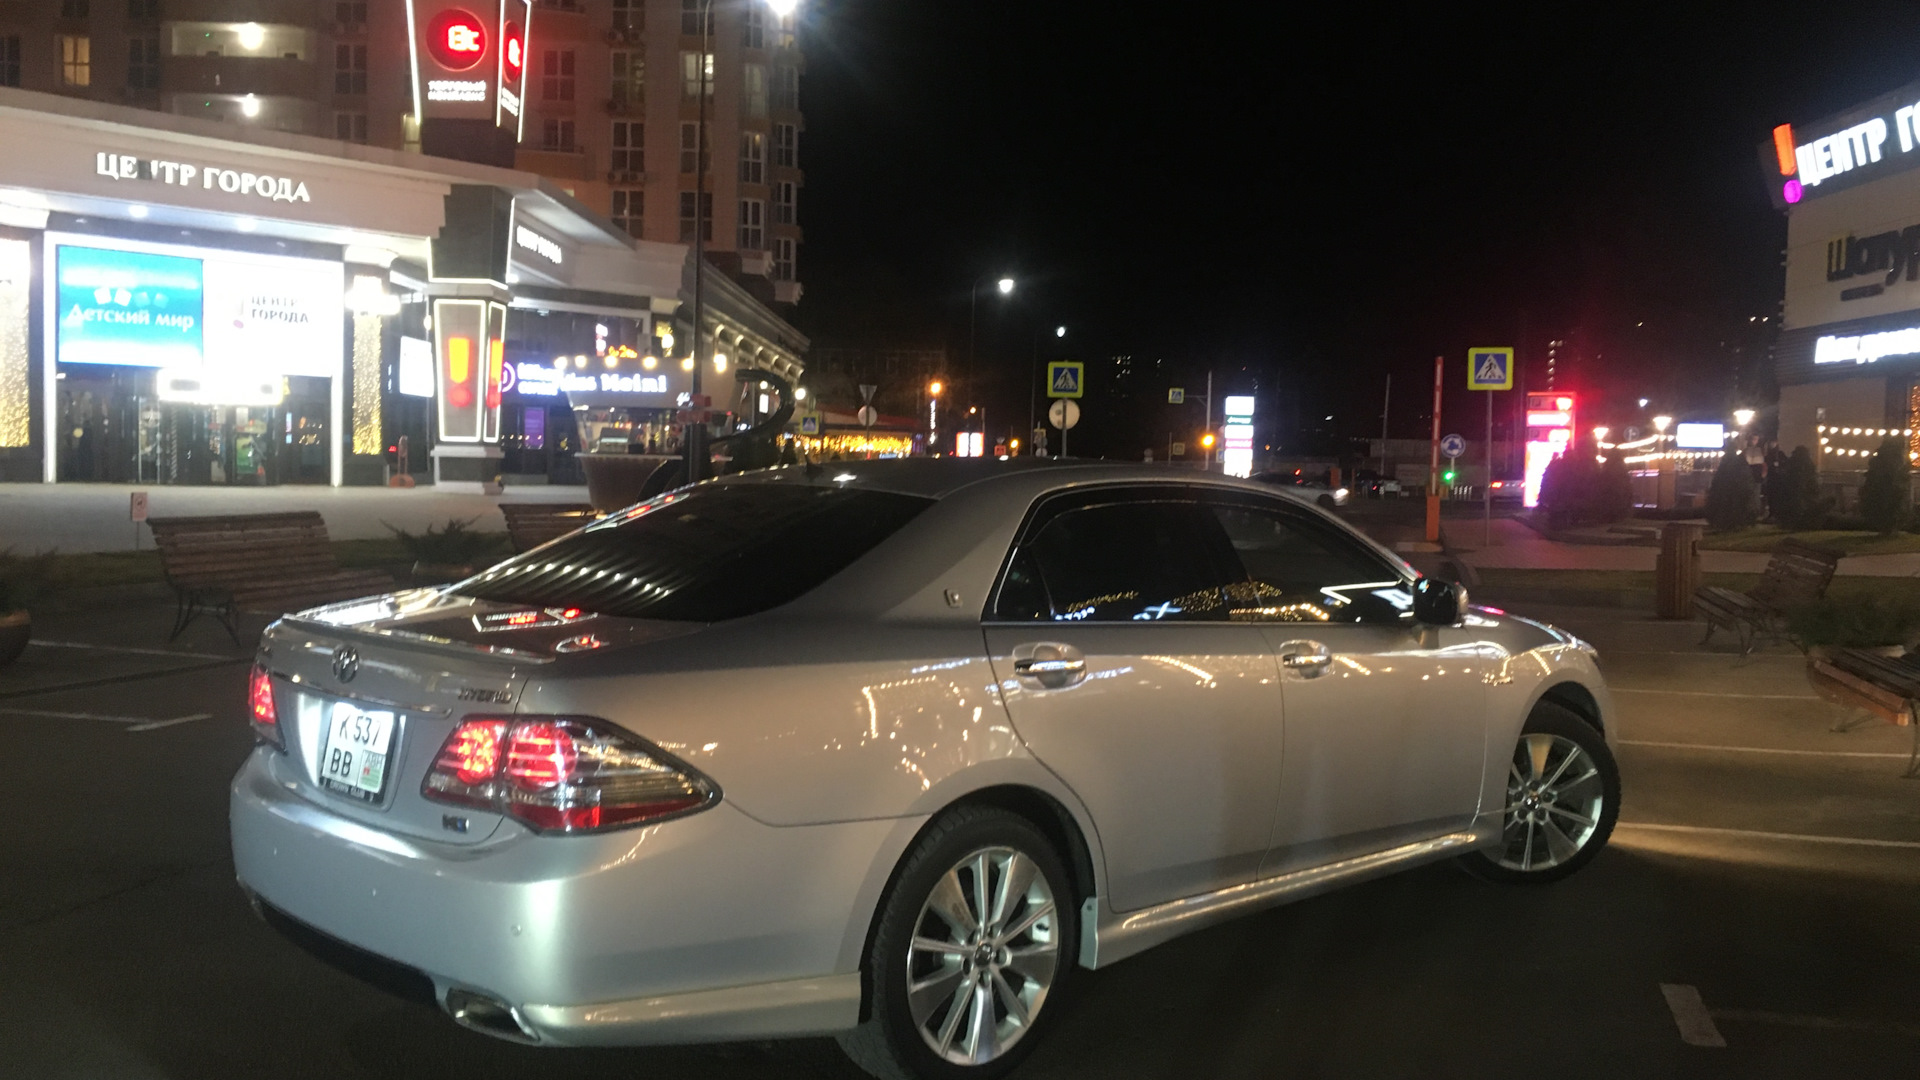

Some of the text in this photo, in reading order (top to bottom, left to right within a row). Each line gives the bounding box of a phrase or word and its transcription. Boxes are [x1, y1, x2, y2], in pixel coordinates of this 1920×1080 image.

[1795, 117, 1887, 187] ЦЕНТР
[202, 166, 311, 204] ГОРОДА
[66, 303, 195, 334] Детский мир
[251, 308, 309, 324] ГОРОДА
